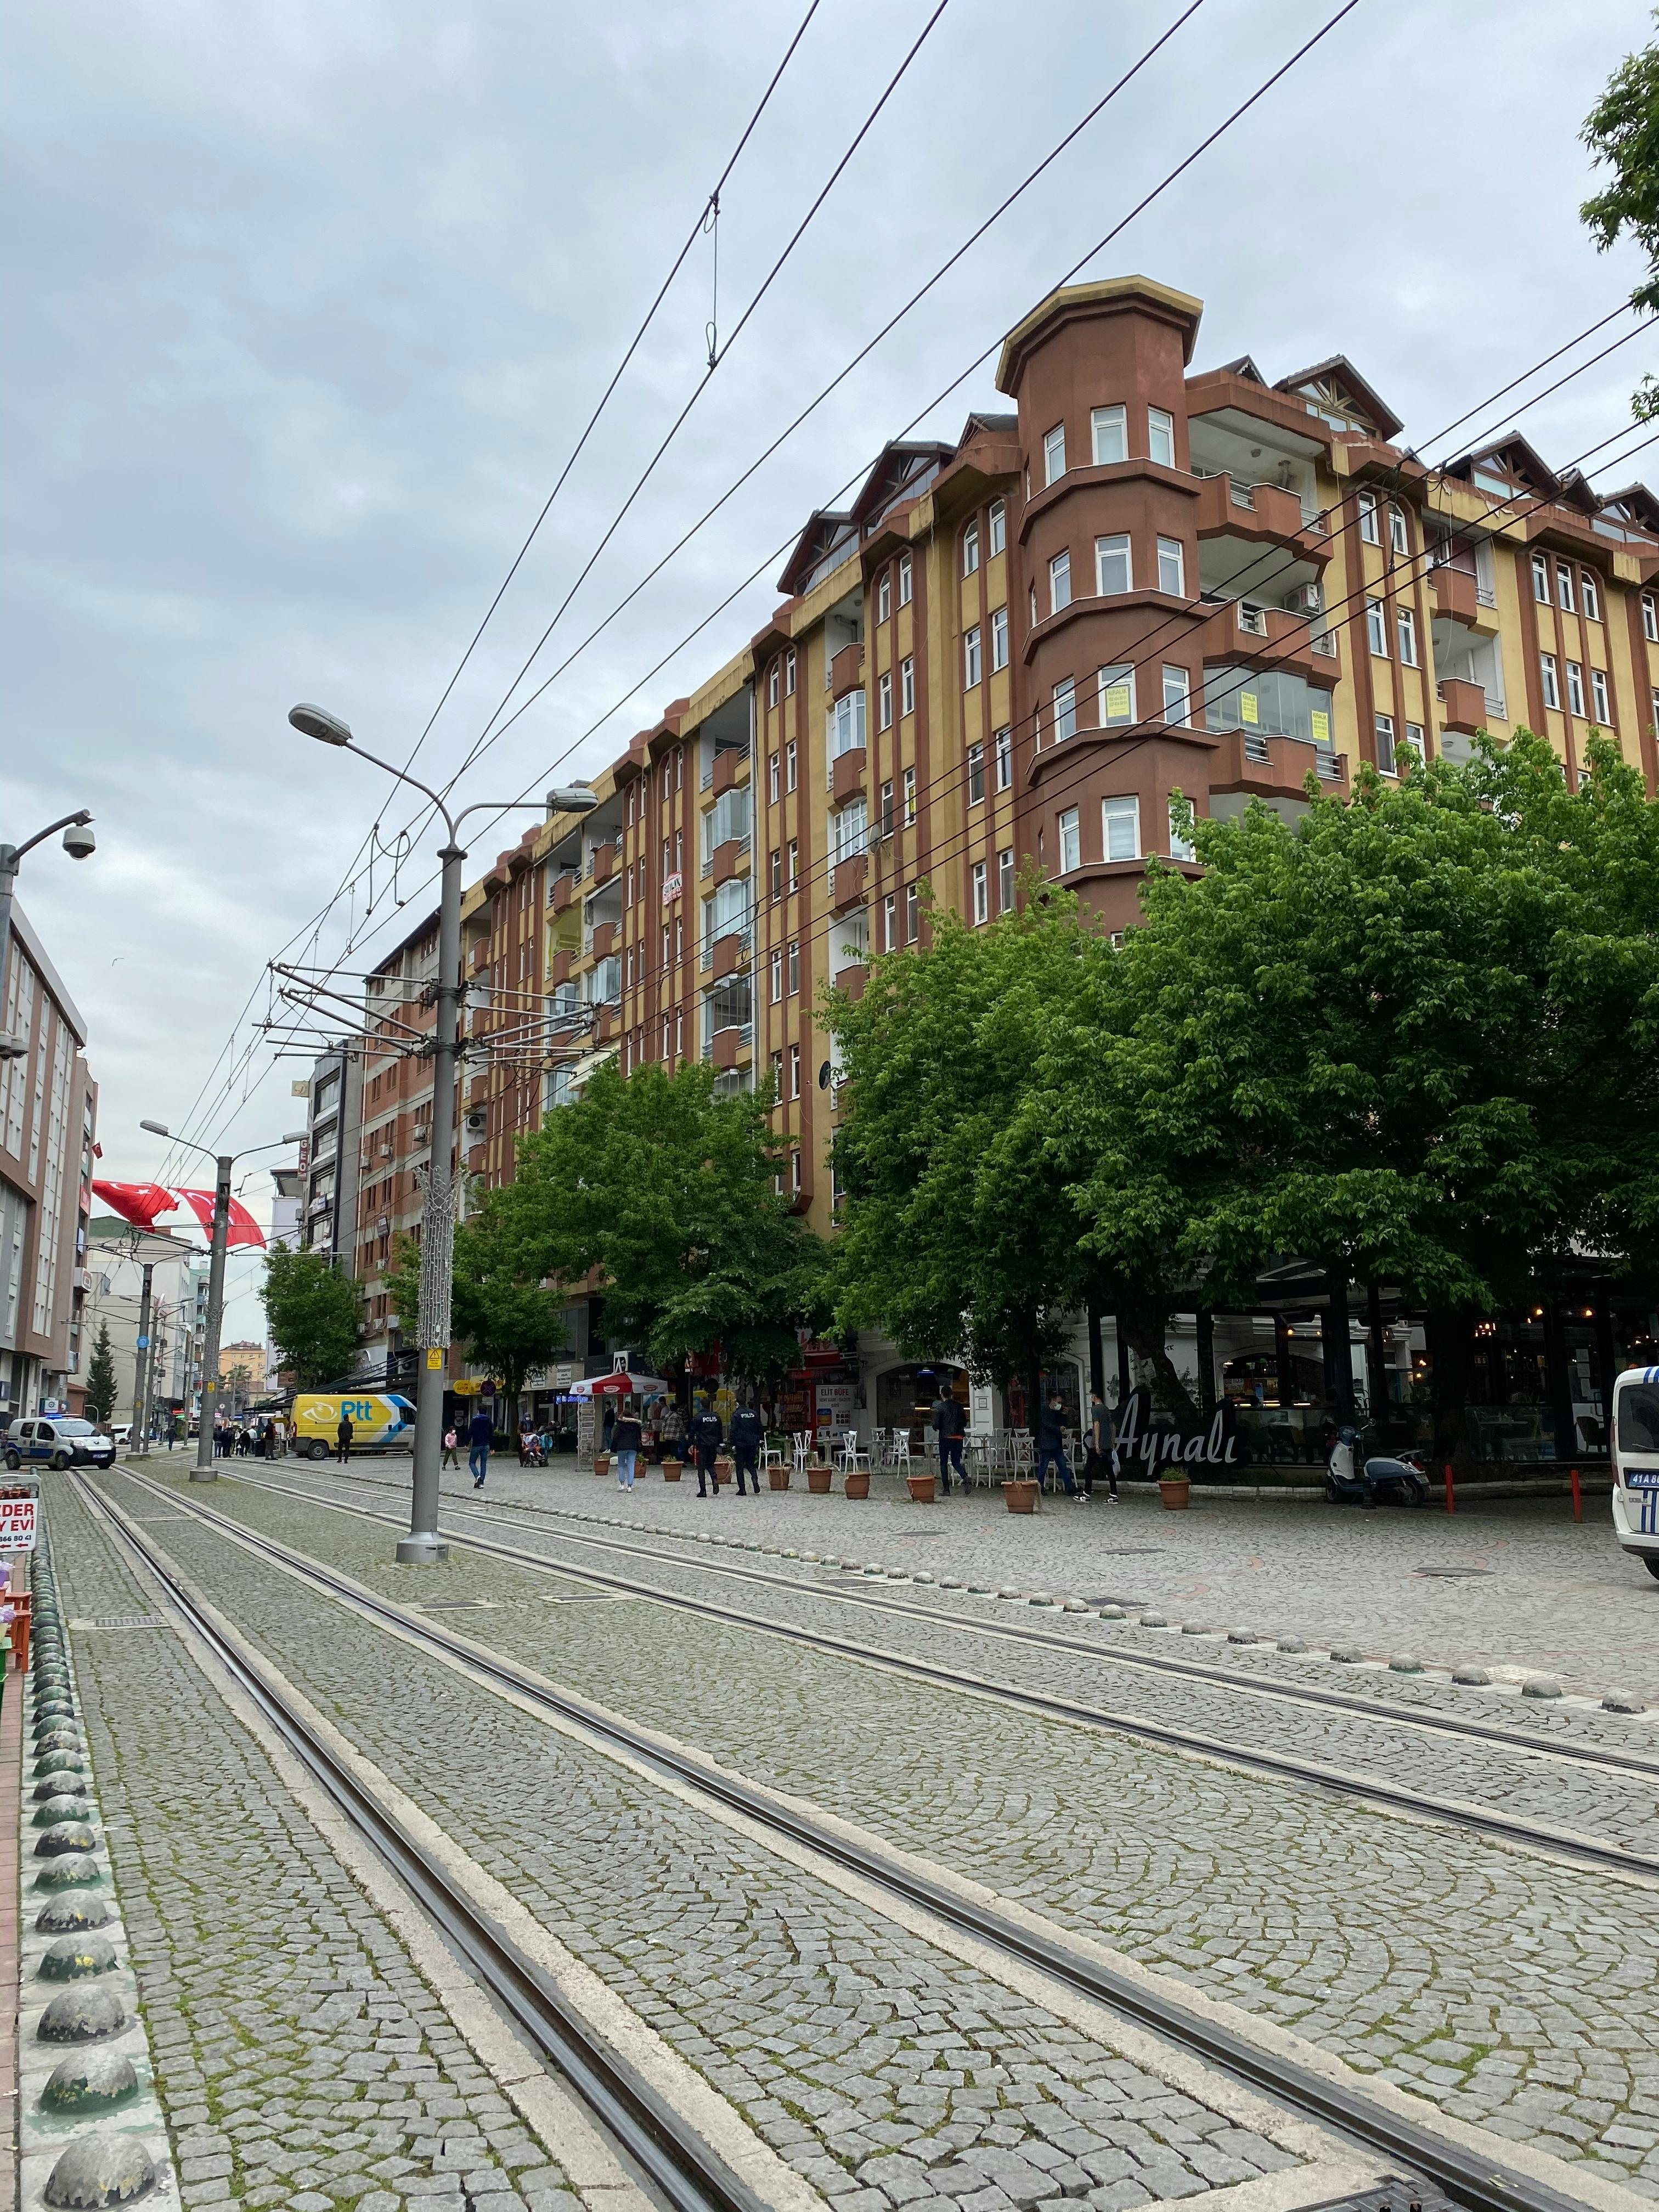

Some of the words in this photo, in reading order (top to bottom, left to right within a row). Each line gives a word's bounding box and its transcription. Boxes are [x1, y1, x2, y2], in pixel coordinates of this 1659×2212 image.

[821, 1387, 833, 1396] ELİT
[834, 1387, 850, 1396] BÜFE
[341, 1401, 373, 1422] Ptt
[0, 1504, 33, 1517] DER
[10, 1516, 34, 1531] EVİ
